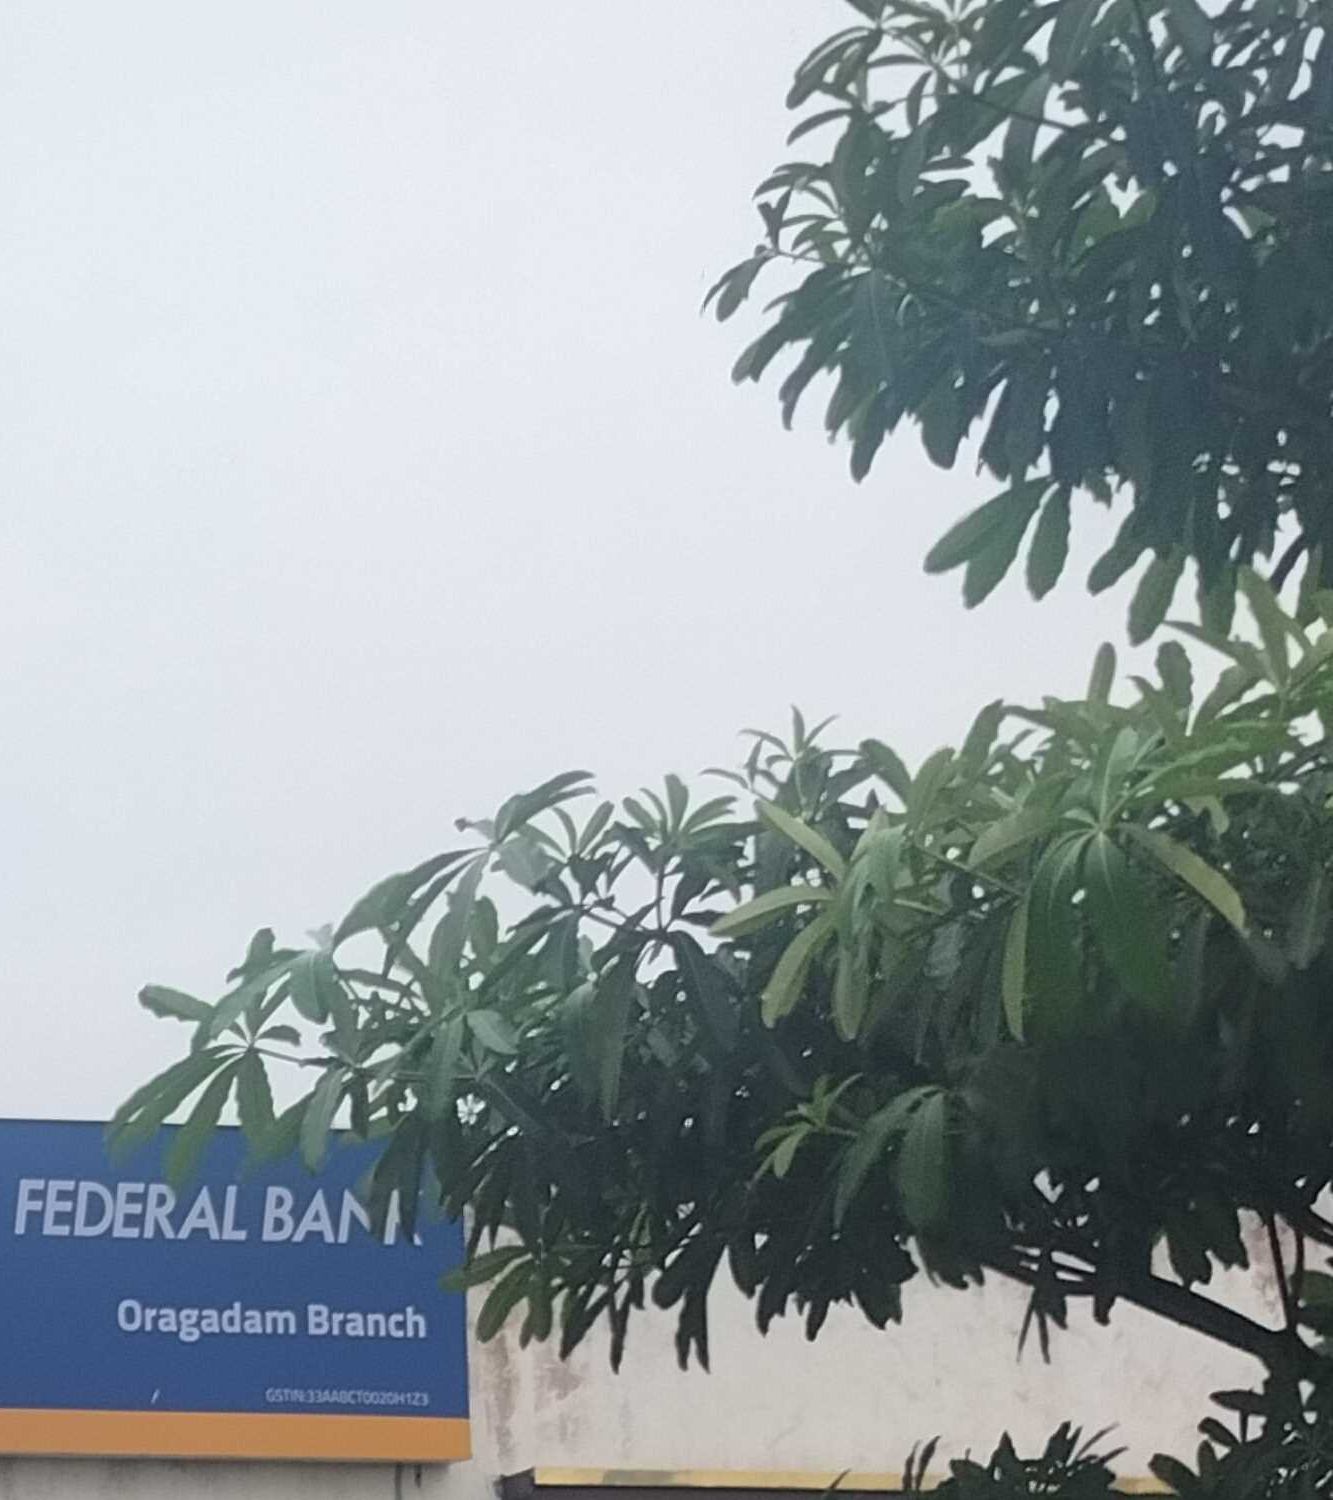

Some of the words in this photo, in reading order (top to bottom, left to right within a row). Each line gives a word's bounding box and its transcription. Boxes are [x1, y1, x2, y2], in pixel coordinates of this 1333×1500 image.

[15, 1178, 247, 1241] FEDERAL
[117, 1299, 296, 1342] Oragadam
[307, 1304, 427, 1338] Branch
